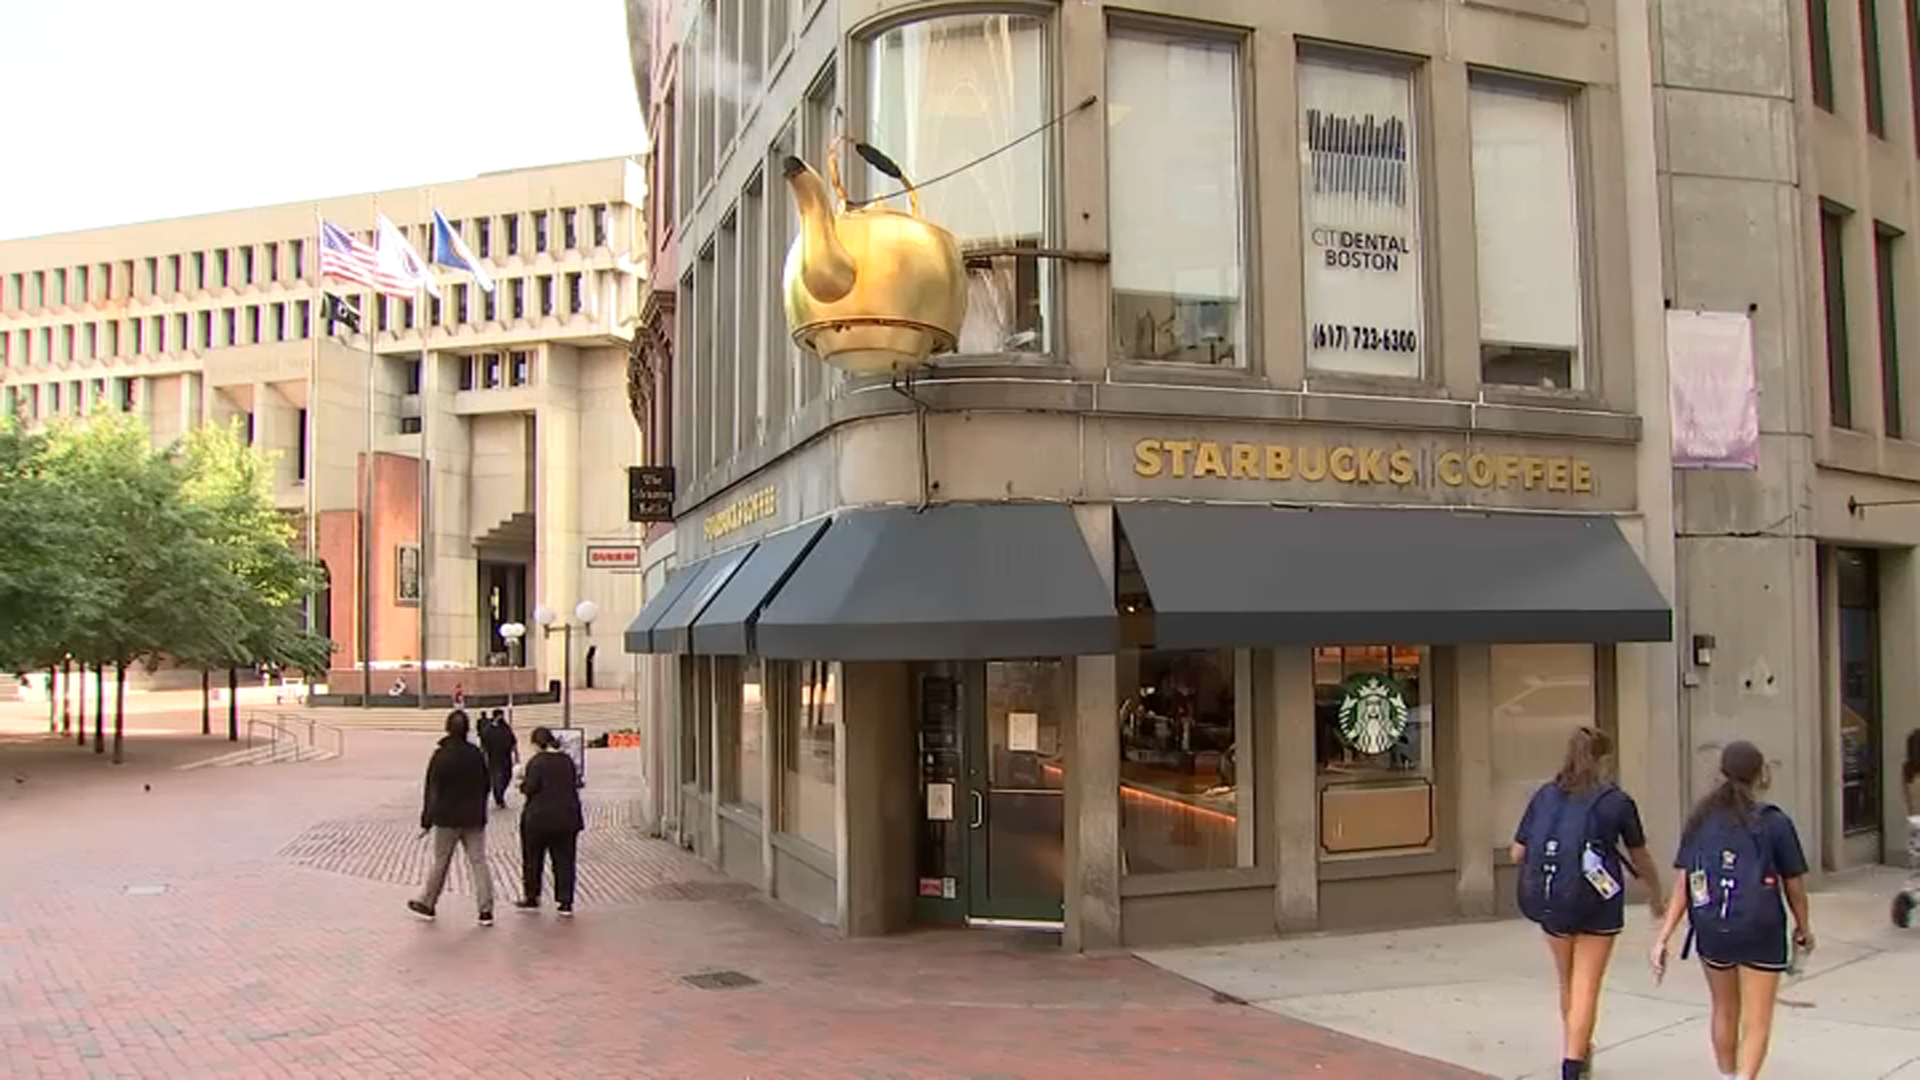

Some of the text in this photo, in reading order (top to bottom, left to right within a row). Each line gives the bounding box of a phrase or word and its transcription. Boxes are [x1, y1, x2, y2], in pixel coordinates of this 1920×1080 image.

[1325, 249, 1398, 271] BOSTON
[1312, 323, 1416, 352] (617) 723-6300
[1134, 438, 1593, 493] STARBUCKS COFFEE
